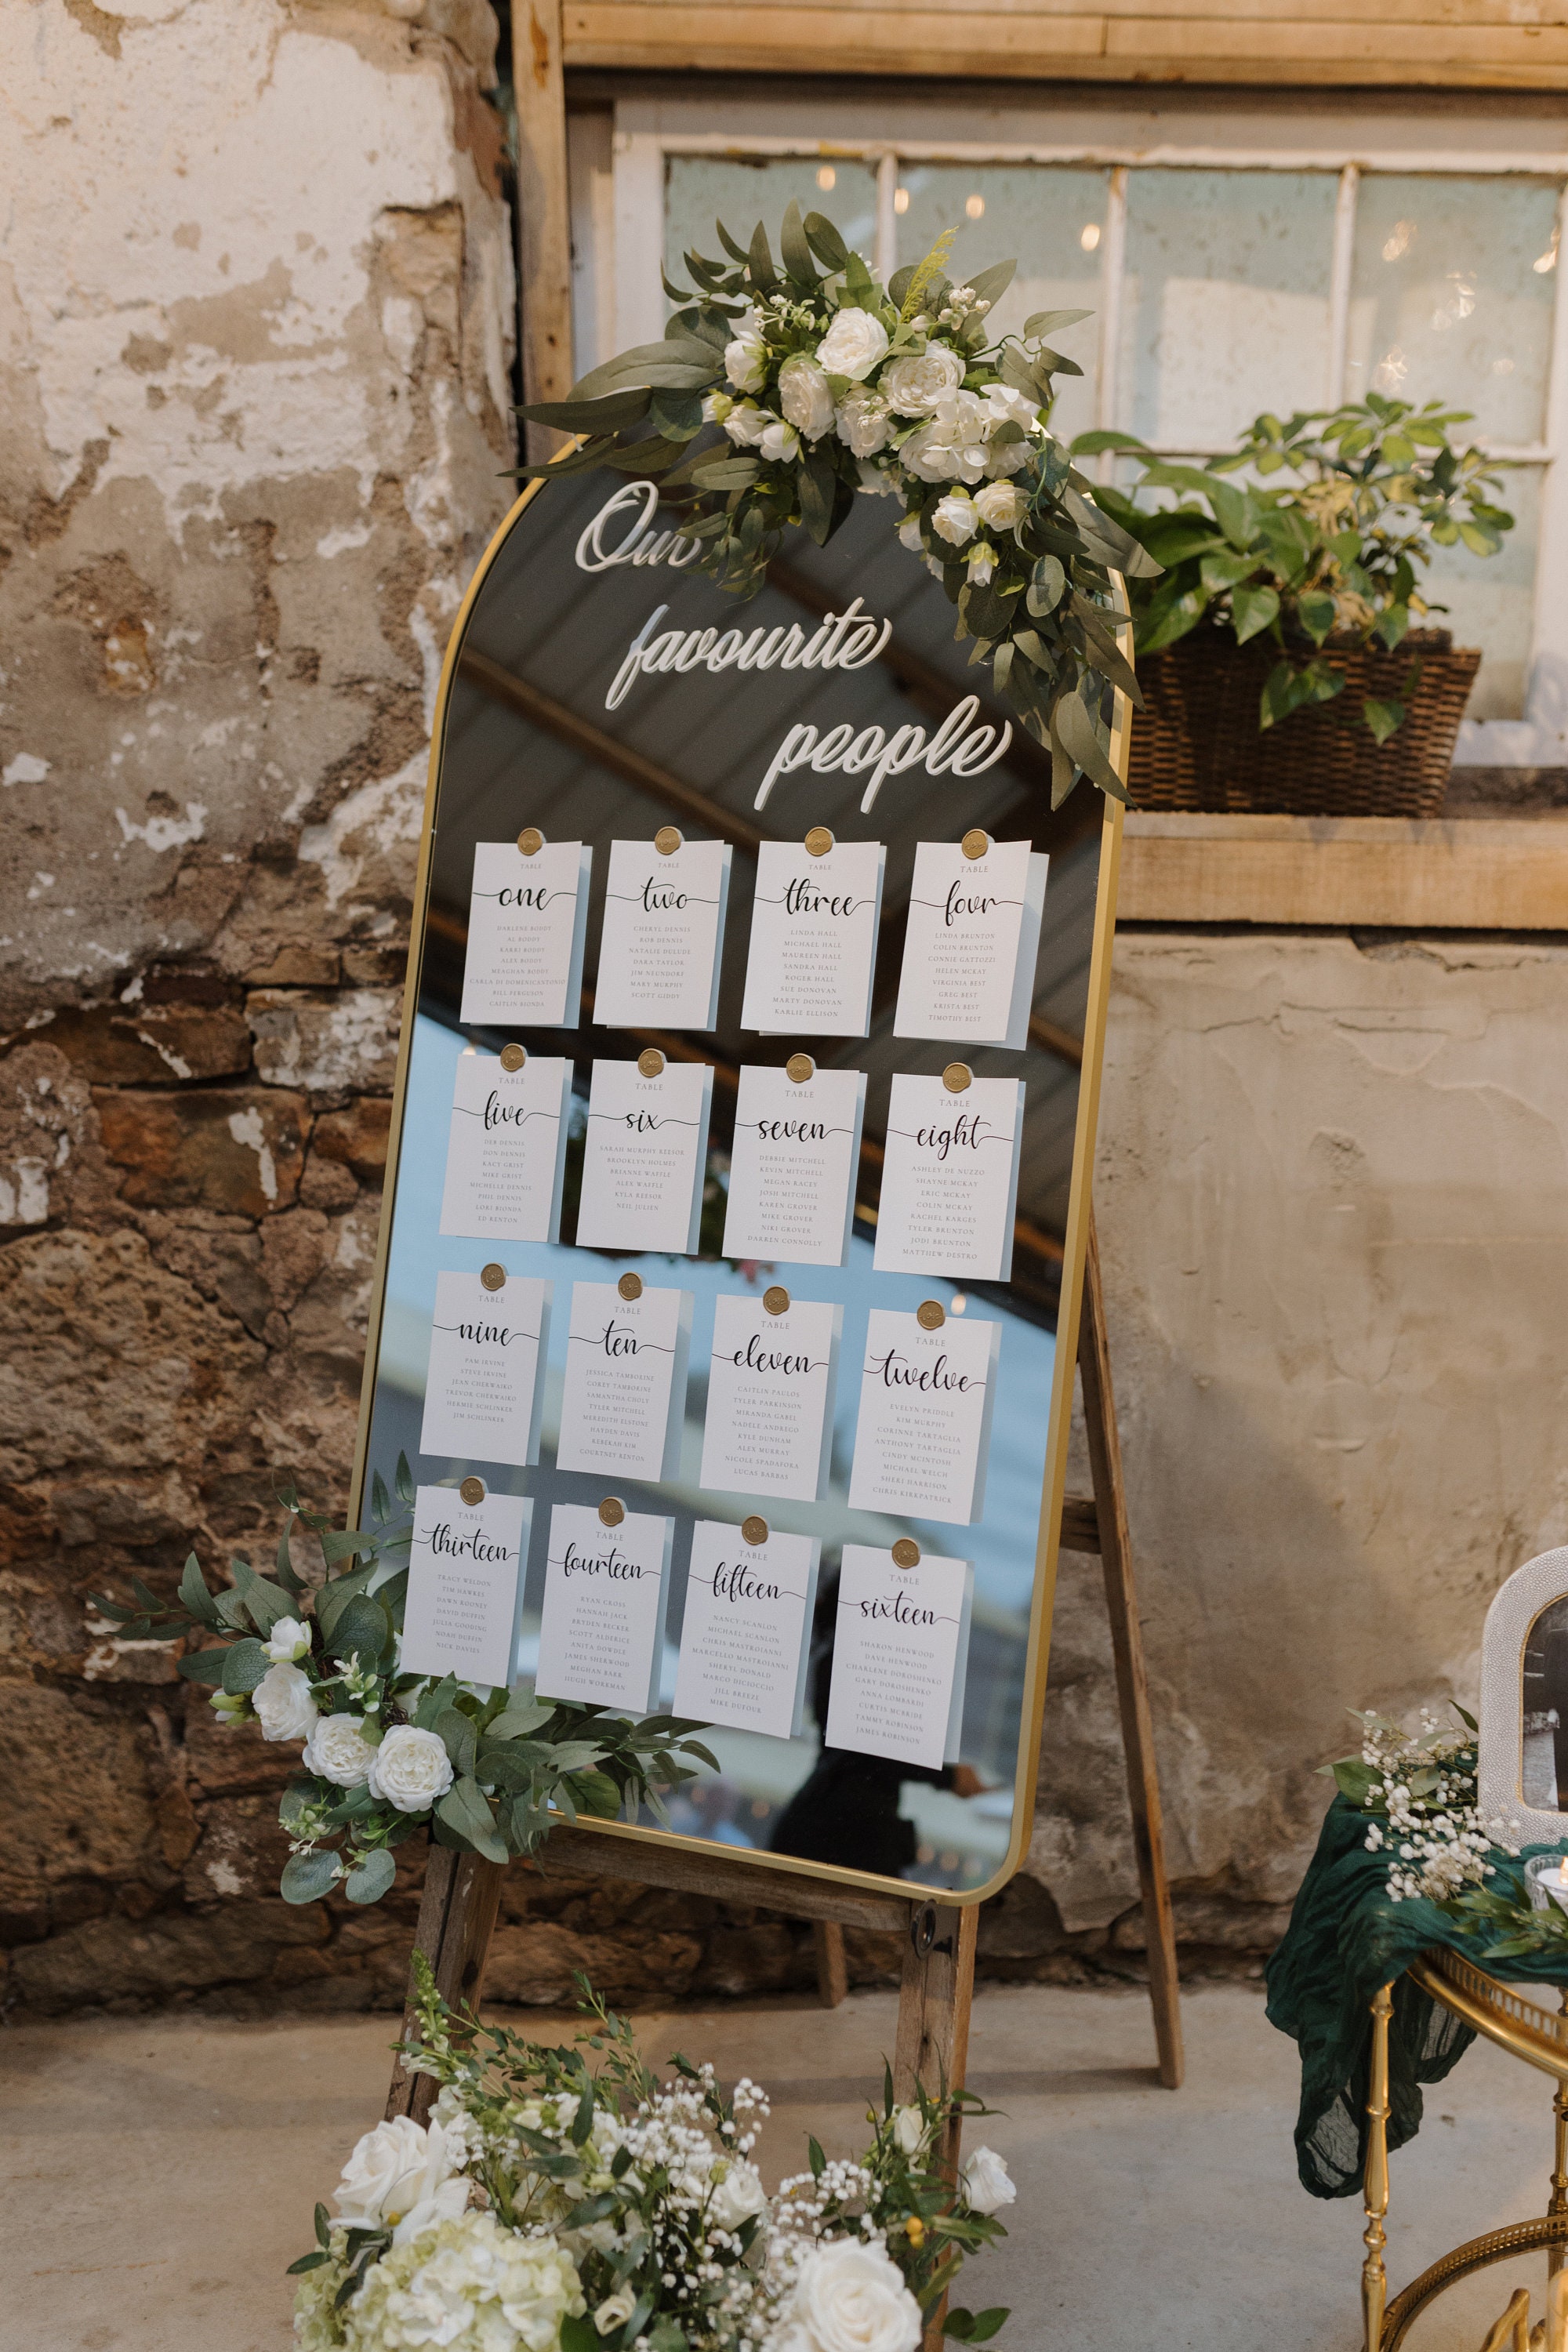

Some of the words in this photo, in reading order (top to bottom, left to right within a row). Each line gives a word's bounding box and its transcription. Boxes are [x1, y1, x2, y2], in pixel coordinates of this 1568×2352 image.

[575, 480, 702, 572] Our
[604, 596, 892, 710] favourite
[753, 695, 1013, 814] people
[754, 878, 876, 916] three
[786, 1090, 815, 1098] TABLE
[735, 1120, 853, 1142] seven
[887, 1115, 1013, 1160] eight
[748, 1235, 779, 1243] DARREN
[782, 1238, 822, 1247] CONNOLLY
[902, 1248, 943, 1258] MATTHEW
[615, 1306, 641, 1315] TABLE
[761, 1321, 790, 1330] TABLE
[915, 1337, 946, 1347] TABLE
[712, 1334, 829, 1374] eleven
[481, 1359, 506, 1367] IRVINE
[616, 1372, 655, 1381] TAMBORINE
[863, 1349, 985, 1392] twelve
[587, 1392, 625, 1402] SAMANTHA
[627, 1396, 650, 1404] CHOLY
[734, 1397, 757, 1406] TYLER
[760, 1399, 802, 1410] PARKINSON
[447, 1400, 474, 1409] HERMIE
[890, 1403, 920, 1413] EVELYN
[923, 1407, 954, 1417] PRIDDLE
[583, 1414, 618, 1424] MEREDITH
[736, 1409, 771, 1418] MIRANDA
[590, 1426, 618, 1436] HAYDEN
[759, 1435, 791, 1444] DUNHAM
[874, 1438, 914, 1449] ANTHONY
[917, 1443, 960, 1455] TARTAGLIA
[882, 1451, 907, 1461] CINDY
[910, 1454, 951, 1465] MCINTOSH
[884, 1464, 918, 1474] MICHAEL
[921, 1468, 948, 1478] WELCH
[458, 1512, 484, 1521] TABLE
[596, 1531, 624, 1541] TABLE
[412, 1523, 520, 1562] thirteen
[548, 1543, 661, 1580] fourteen
[739, 1550, 768, 1561] TABLE
[689, 1562, 807, 1602] fifteen
[889, 1574, 920, 1585] TABLE
[457, 1588, 485, 1597] HAWKES
[580, 1596, 601, 1605] RYAN
[603, 1599, 626, 1608] CROSS
[838, 1591, 960, 1625] sixteen
[433, 1618, 452, 1627] JULIA
[455, 1621, 487, 1632] GOODING
[572, 1619, 601, 1628] BRYDEN
[603, 1623, 630, 1632] BECKER
[713, 1615, 739, 1625] NANCY
[742, 1620, 778, 1632] SCANLON
[568, 1630, 593, 1639] SCOTT
[436, 1642, 453, 1650] NICK
[456, 1645, 480, 1653] DAVIES
[702, 1637, 727, 1647] CHRIS
[709, 1662, 738, 1673] SHERYL
[740, 1668, 771, 1679] DONALD
[846, 1664, 887, 1676] CHARLENE
